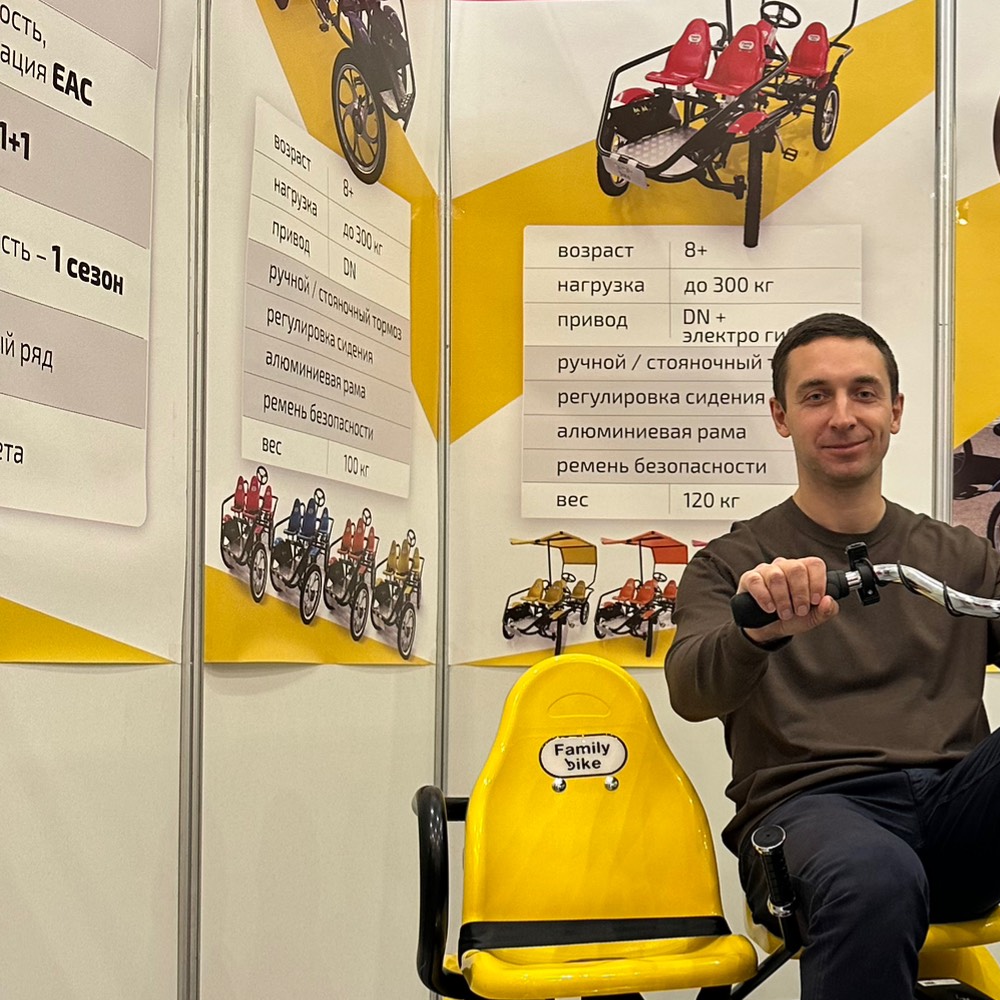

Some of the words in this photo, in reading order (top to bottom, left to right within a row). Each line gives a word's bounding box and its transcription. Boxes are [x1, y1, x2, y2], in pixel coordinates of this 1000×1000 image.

[0, 4, 46, 49] ость,
[1, 44, 47, 84] ация
[274, 134, 312, 172] возраст
[343, 178, 354, 198] 8+
[274, 177, 318, 216] нагрузка
[343, 223, 354, 240] до
[356, 225, 373, 250] 300
[374, 240, 383, 255] кг
[1, 235, 30, 261] сть
[52, 245, 61, 273] 1
[67, 257, 123, 295] сезон
[272, 221, 311, 257] привод
[343, 257, 356, 280] DN
[559, 246, 634, 262] возраст
[685, 242, 707, 257] 8+
[558, 280, 644, 296] нагрузка
[684, 281, 707, 295] до
[713, 277, 748, 293] 300
[755, 281, 774, 292] кг
[269, 264, 310, 295] ручной
[312, 281, 317, 298] /
[319, 287, 370, 326] стояночный
[372, 315, 402, 341] тормоз
[267, 307, 335, 347] регулировка
[337, 337, 373, 364] сидения
[558, 315, 628, 331] привод
[684, 309, 709, 324] DN
[716, 313, 726, 322] +
[682, 330, 759, 346] электро
[20, 342, 53, 373] ряд
[558, 354, 625, 373] ручной
[631, 354, 641, 371] /
[647, 354, 761, 370] стояночный
[266, 351, 341, 389] алюминиевая
[343, 380, 366, 399] рама
[558, 392, 679, 408] регулировка
[686, 393, 764, 407] сидения
[263, 394, 307, 420] ремень
[310, 403, 374, 441] безопасности
[558, 427, 691, 439] алюминиевая
[698, 428, 746, 443] рама
[262, 437, 282, 455] вес
[344, 455, 359, 475] 100
[360, 463, 369, 478] кг
[557, 461, 629, 476] ремень
[635, 457, 766, 474] безопасности
[557, 495, 588, 507] вес
[683, 492, 714, 508] 120
[721, 497, 740, 508] кг
[554, 741, 610, 756] Family
[565, 758, 601, 771] bike
